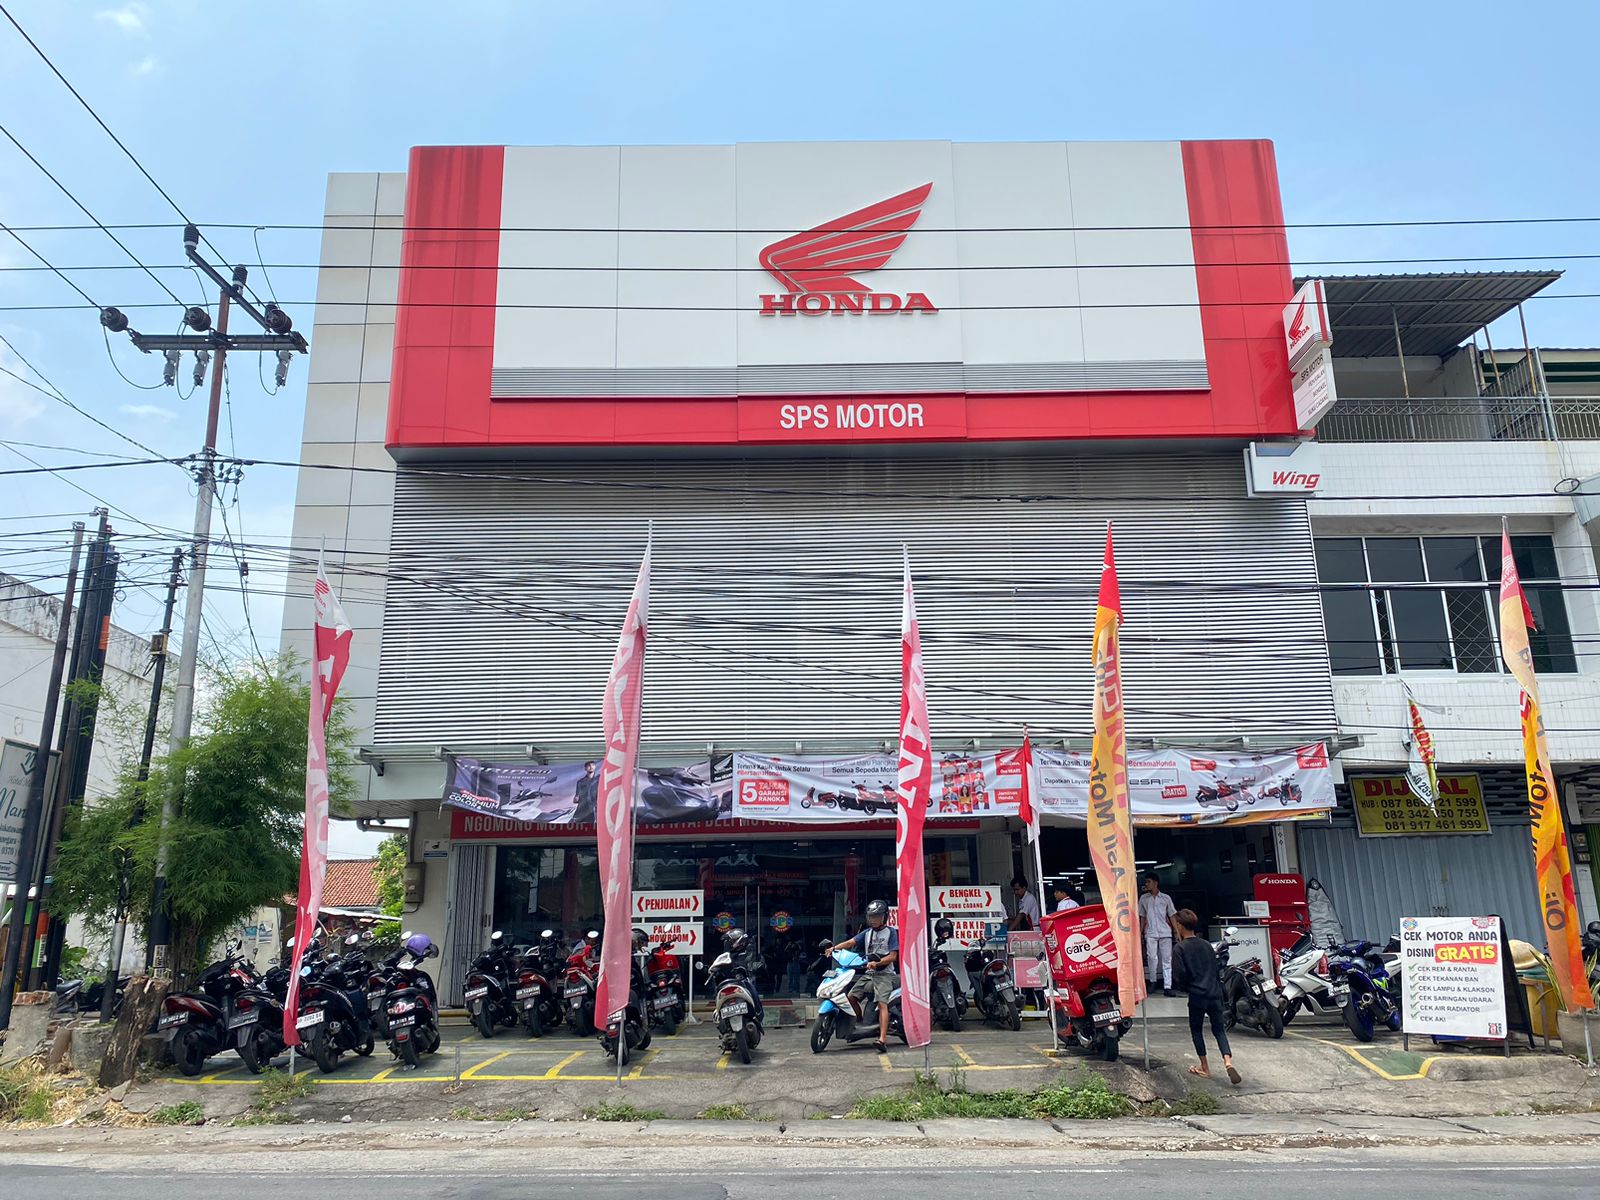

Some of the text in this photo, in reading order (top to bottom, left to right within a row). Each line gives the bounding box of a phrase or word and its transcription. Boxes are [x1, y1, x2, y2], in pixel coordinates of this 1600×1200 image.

[759, 293, 939, 316] HONDA
[1289, 325, 1310, 350] HONDA
[1300, 353, 1324, 381] SPS MOTOR
[780, 403, 924, 429] SPS MOTOR
[1272, 471, 1320, 488] Wing
[1128, 760, 1176, 768] BersamaHonda
[742, 781, 758, 803] 5
[1363, 779, 1469, 796] DIJAL
[1381, 799, 1402, 808] 087
[1456, 798, 1477, 807] 599
[1382, 810, 1404, 819] 082
[1408, 810, 1429, 818] 342
[1457, 809, 1479, 818] 759
[1385, 819, 1482, 830] 081 917 461 999
[949, 889, 981, 898] BENGKEL
[645, 898, 691, 910] PENJUALAN
[712, 917, 736, 927] SPS
[770, 917, 793, 927] SPS
[653, 925, 681, 934] PAIR
[991, 923, 1001, 936] P
[648, 934, 689, 942] HOWROOM
[955, 931, 983, 939] ENGKE
[1404, 931, 1498, 941] CEK MOTOR ANDA
[1231, 938, 1259, 946] Bengkel
[1407, 945, 1495, 961] DISINI GRATIS
[1418, 985, 1495, 993] CEK LAMPU & KLAKSON
